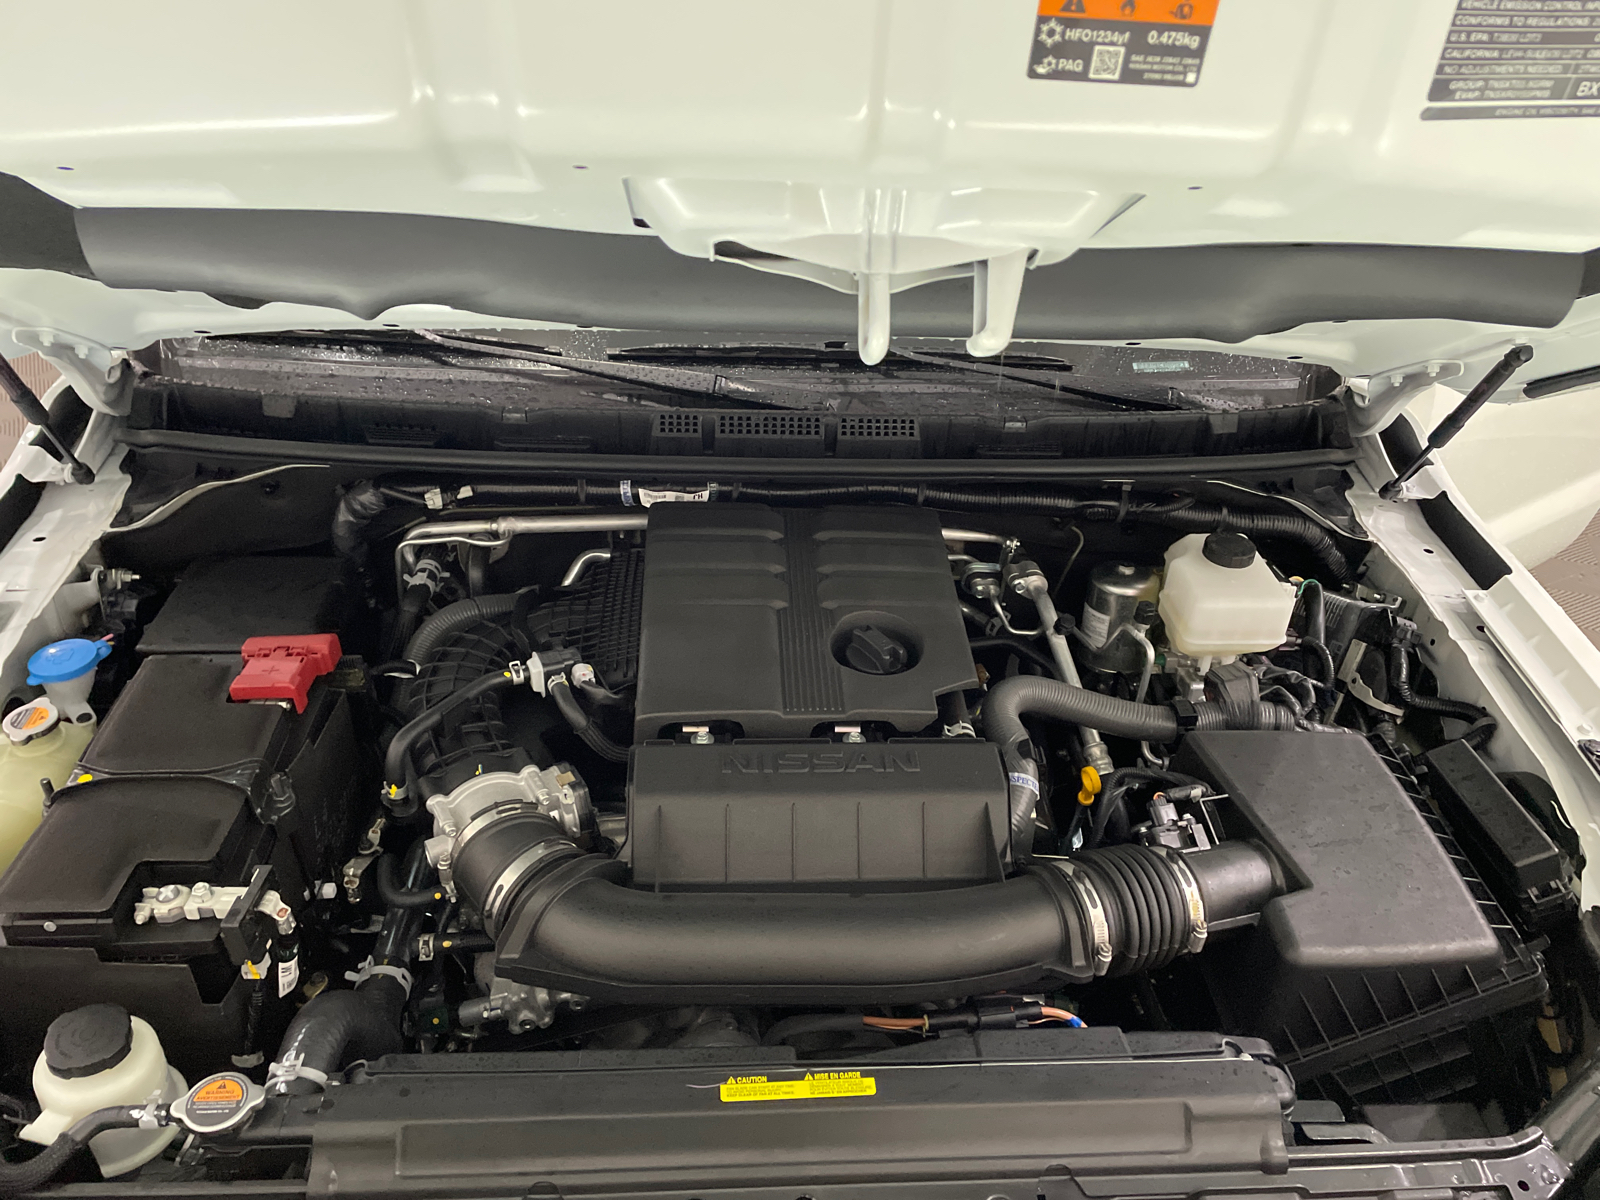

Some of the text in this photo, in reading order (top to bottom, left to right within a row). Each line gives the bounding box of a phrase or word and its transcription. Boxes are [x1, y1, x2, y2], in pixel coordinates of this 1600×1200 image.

[1454, 15, 1511, 26] CONFORMS
[1512, 16, 1526, 26] TO
[1065, 27, 1200, 50] HFO1234yf 0.475kg
[1058, 58, 1084, 73] PAG
[721, 750, 921, 774] NISSAN
[736, 1075, 768, 1084] CAUTION
[813, 1071, 862, 1080] MISE EN GARDE
